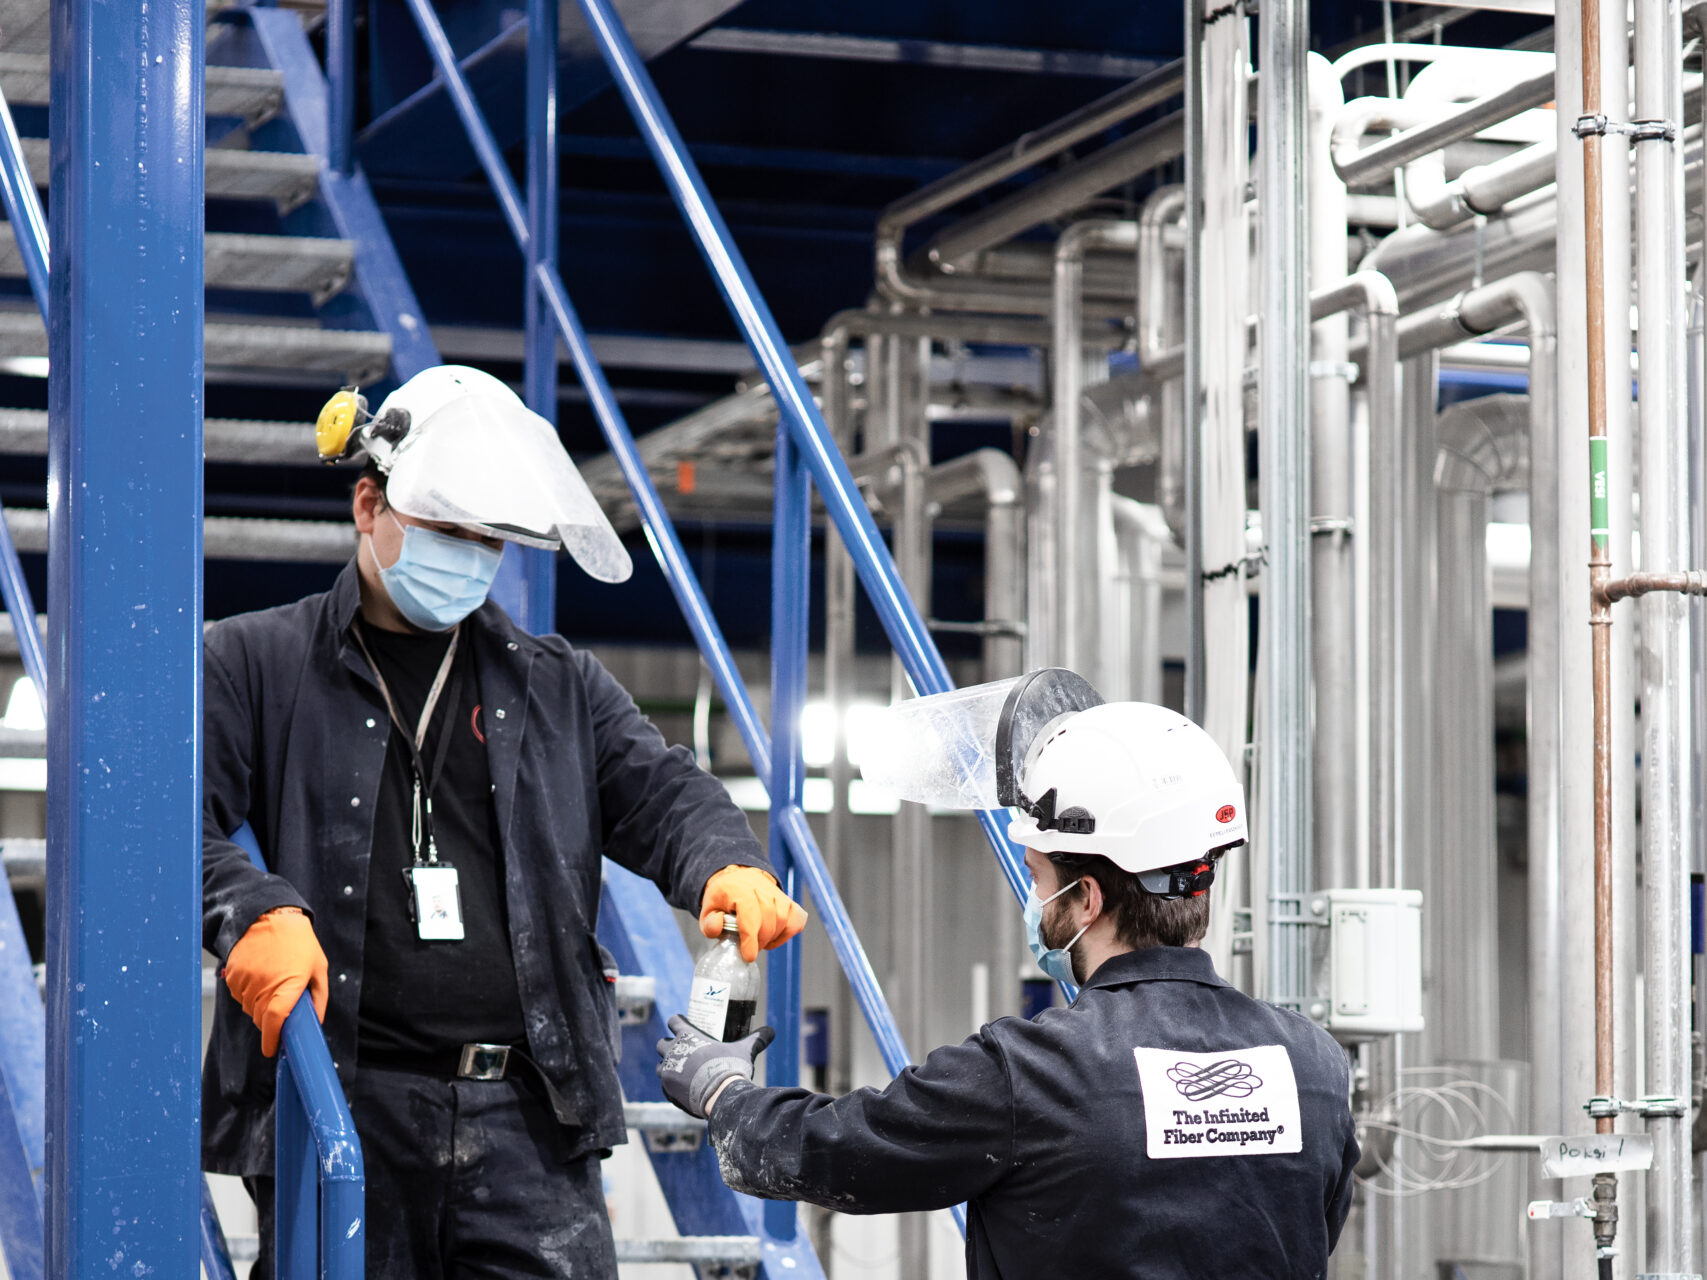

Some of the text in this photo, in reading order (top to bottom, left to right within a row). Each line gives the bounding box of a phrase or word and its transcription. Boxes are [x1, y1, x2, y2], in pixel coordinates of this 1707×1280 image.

[1173, 1107, 1270, 1125] The Infinited
[1164, 1129, 1204, 1144] Fiber
